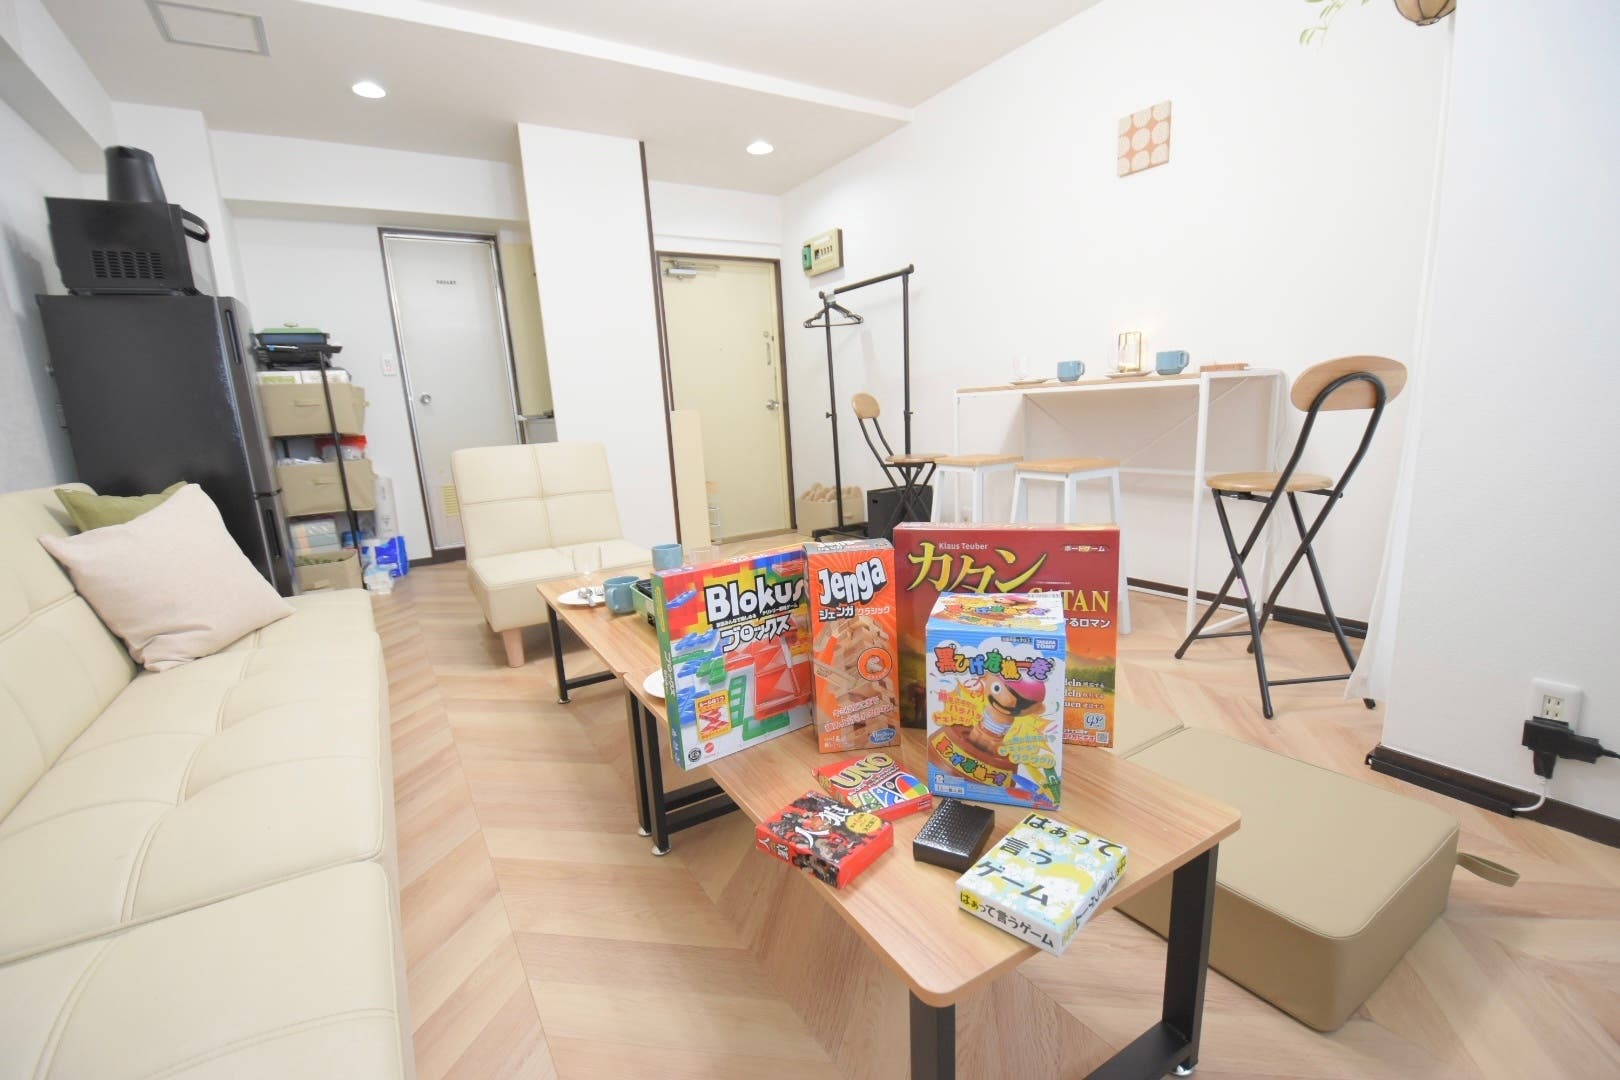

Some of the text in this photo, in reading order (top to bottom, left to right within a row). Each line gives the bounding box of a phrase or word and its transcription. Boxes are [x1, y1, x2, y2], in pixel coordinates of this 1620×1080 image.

[938, 542, 989, 551] Klaus Teuber
[818, 556, 888, 606] Jenga
[906, 541, 1048, 594] カタン
[819, 604, 891, 621] ジェンガ クラシック
[1063, 616, 1111, 629] るロマン
[720, 613, 791, 653] ブロックス
[829, 752, 894, 789] UNO
[1000, 837, 1053, 865] 言う
[976, 860, 1049, 907] ゲーム
